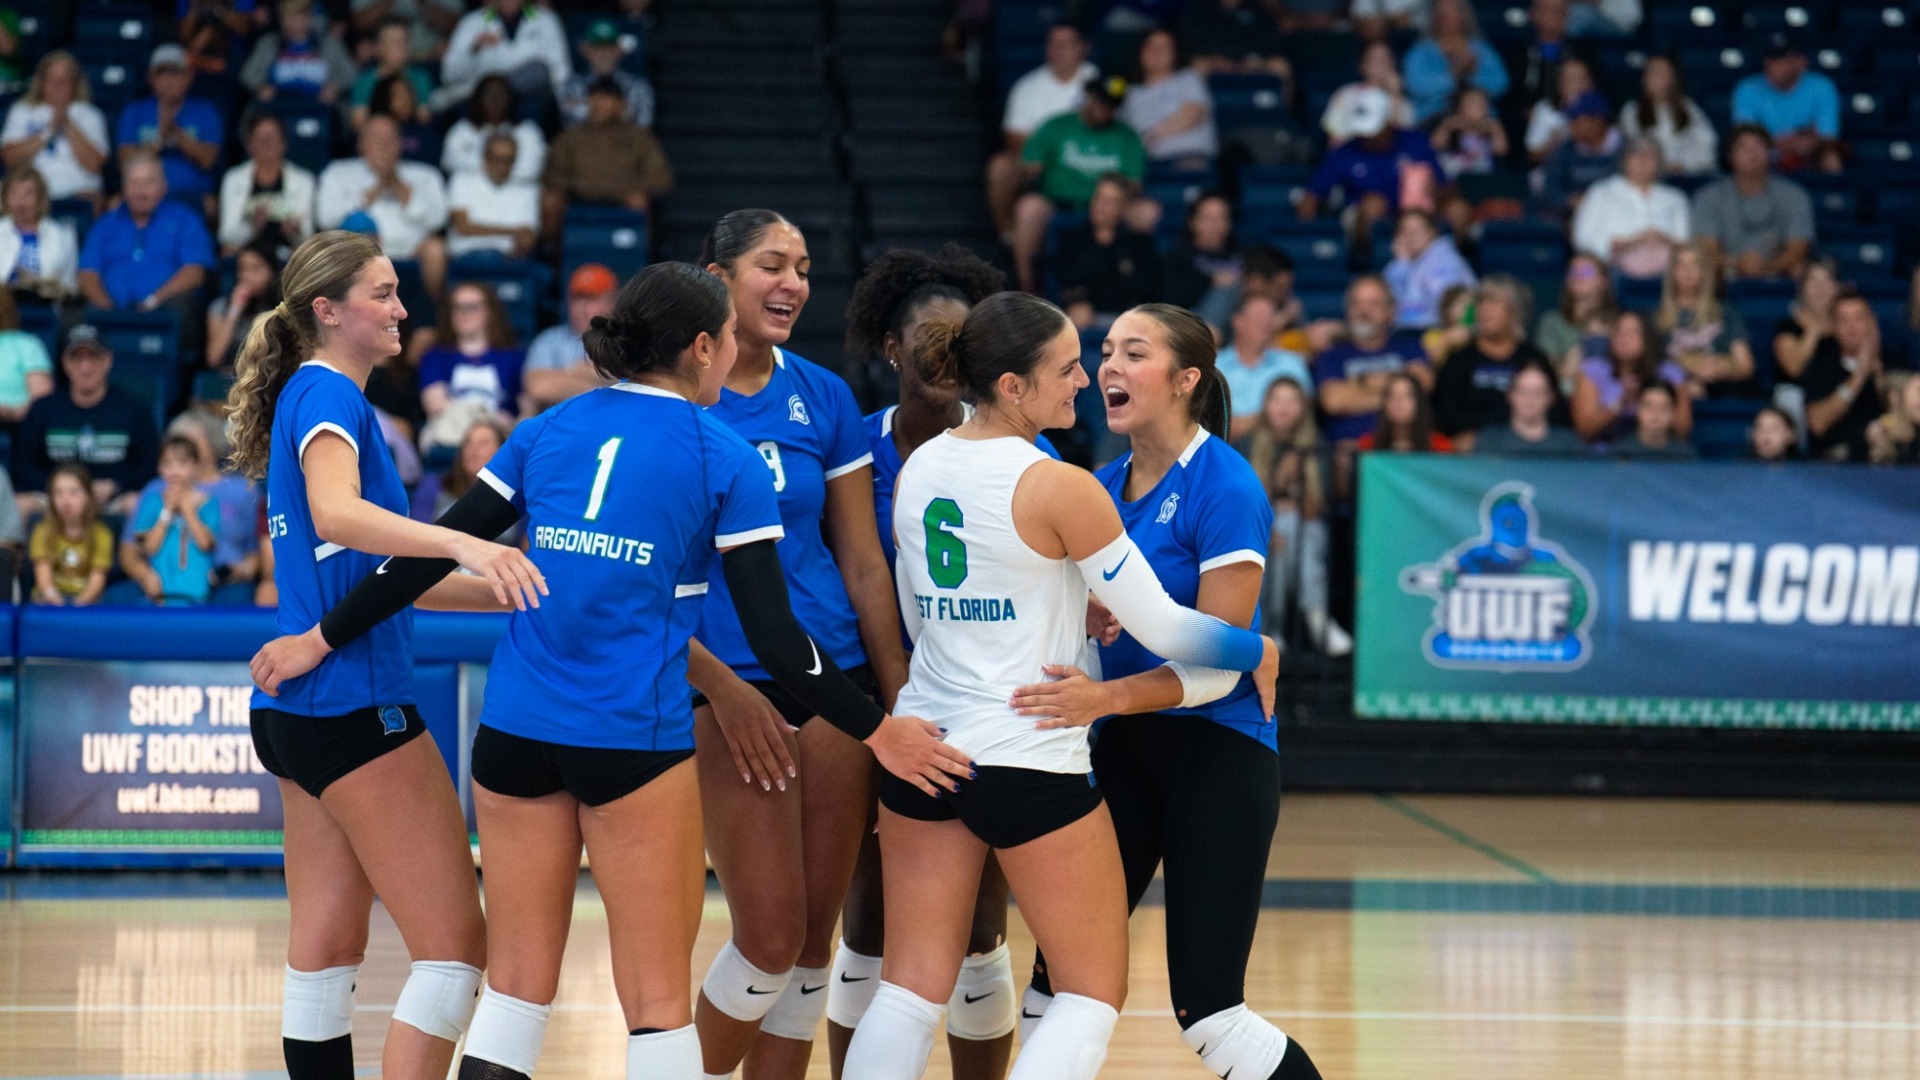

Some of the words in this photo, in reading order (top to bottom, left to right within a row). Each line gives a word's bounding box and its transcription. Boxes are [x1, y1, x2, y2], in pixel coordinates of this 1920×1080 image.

[583, 436, 623, 522] 1
[757, 441, 786, 492] 9
[535, 525, 655, 566] ARGONAUTS
[923, 497, 968, 589] 6
[1628, 541, 1920, 626] WELCOM
[938, 597, 1017, 622] FLORIDA
[1449, 590, 1571, 642] UWF
[129, 684, 203, 726] SHOP
[82, 733, 143, 774] UWF
